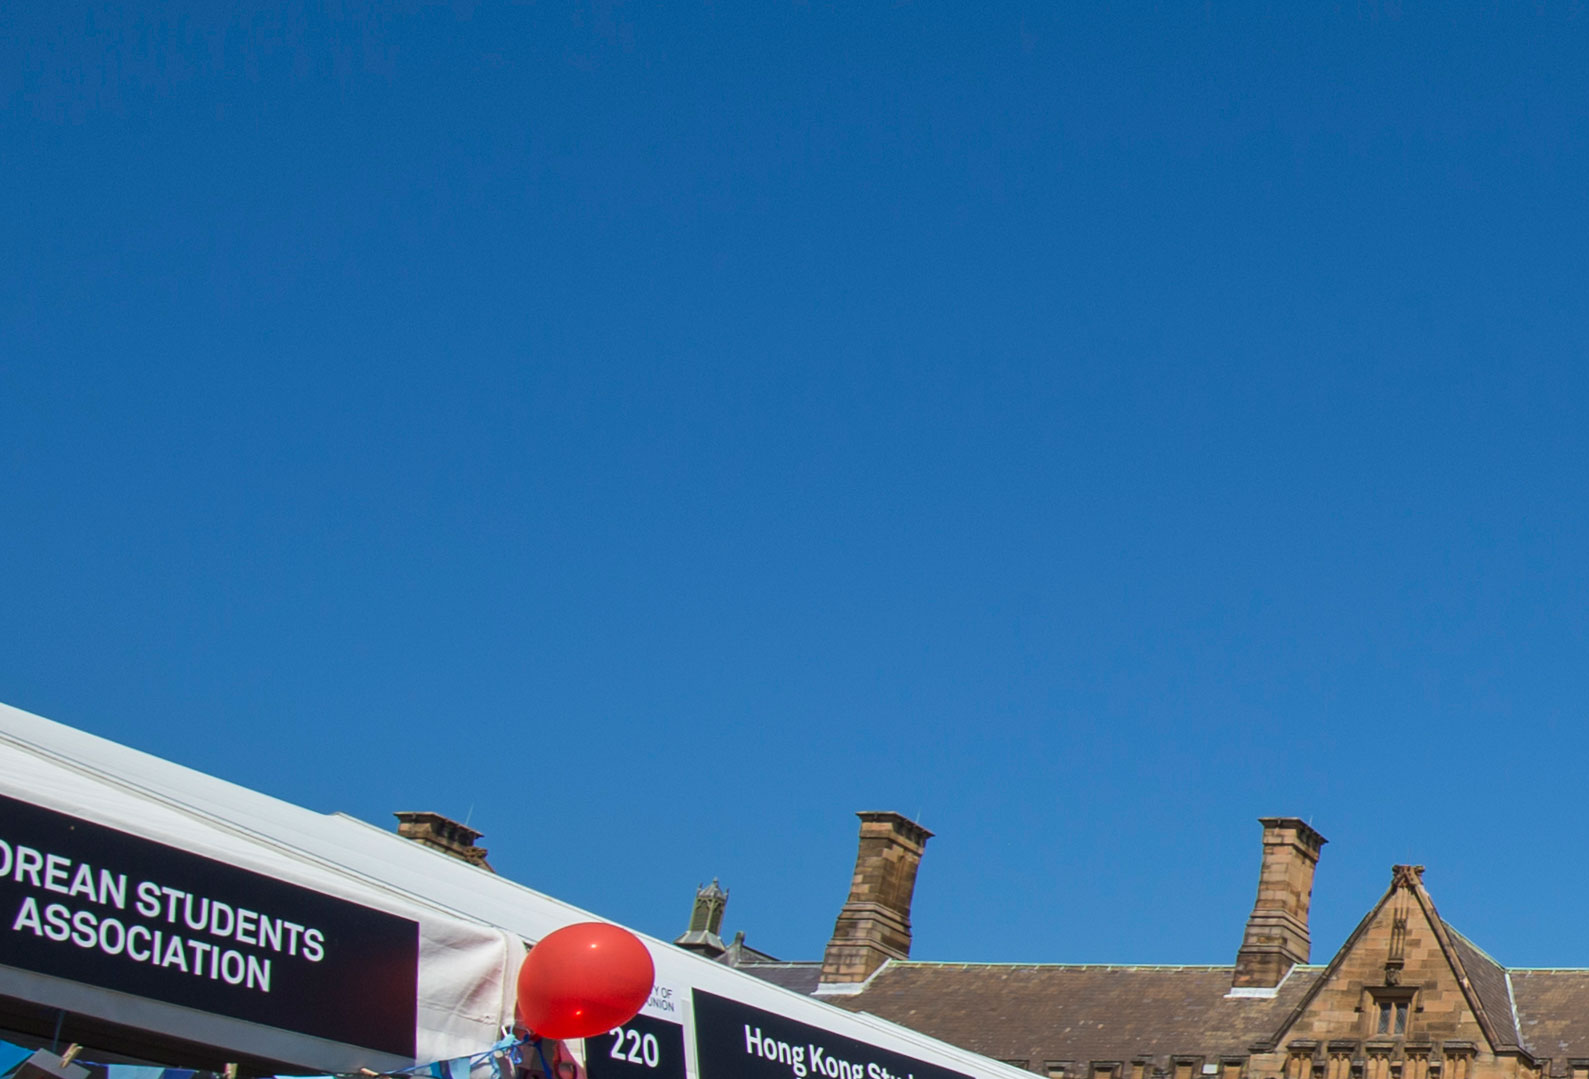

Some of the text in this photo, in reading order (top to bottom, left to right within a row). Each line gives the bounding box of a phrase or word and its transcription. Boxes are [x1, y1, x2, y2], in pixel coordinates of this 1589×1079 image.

[12, 896, 271, 992] ASSOCIATION
[136, 881, 325, 962] STUDENTS
[608, 1026, 660, 1068] 220
[744, 1024, 808, 1078] Hong
